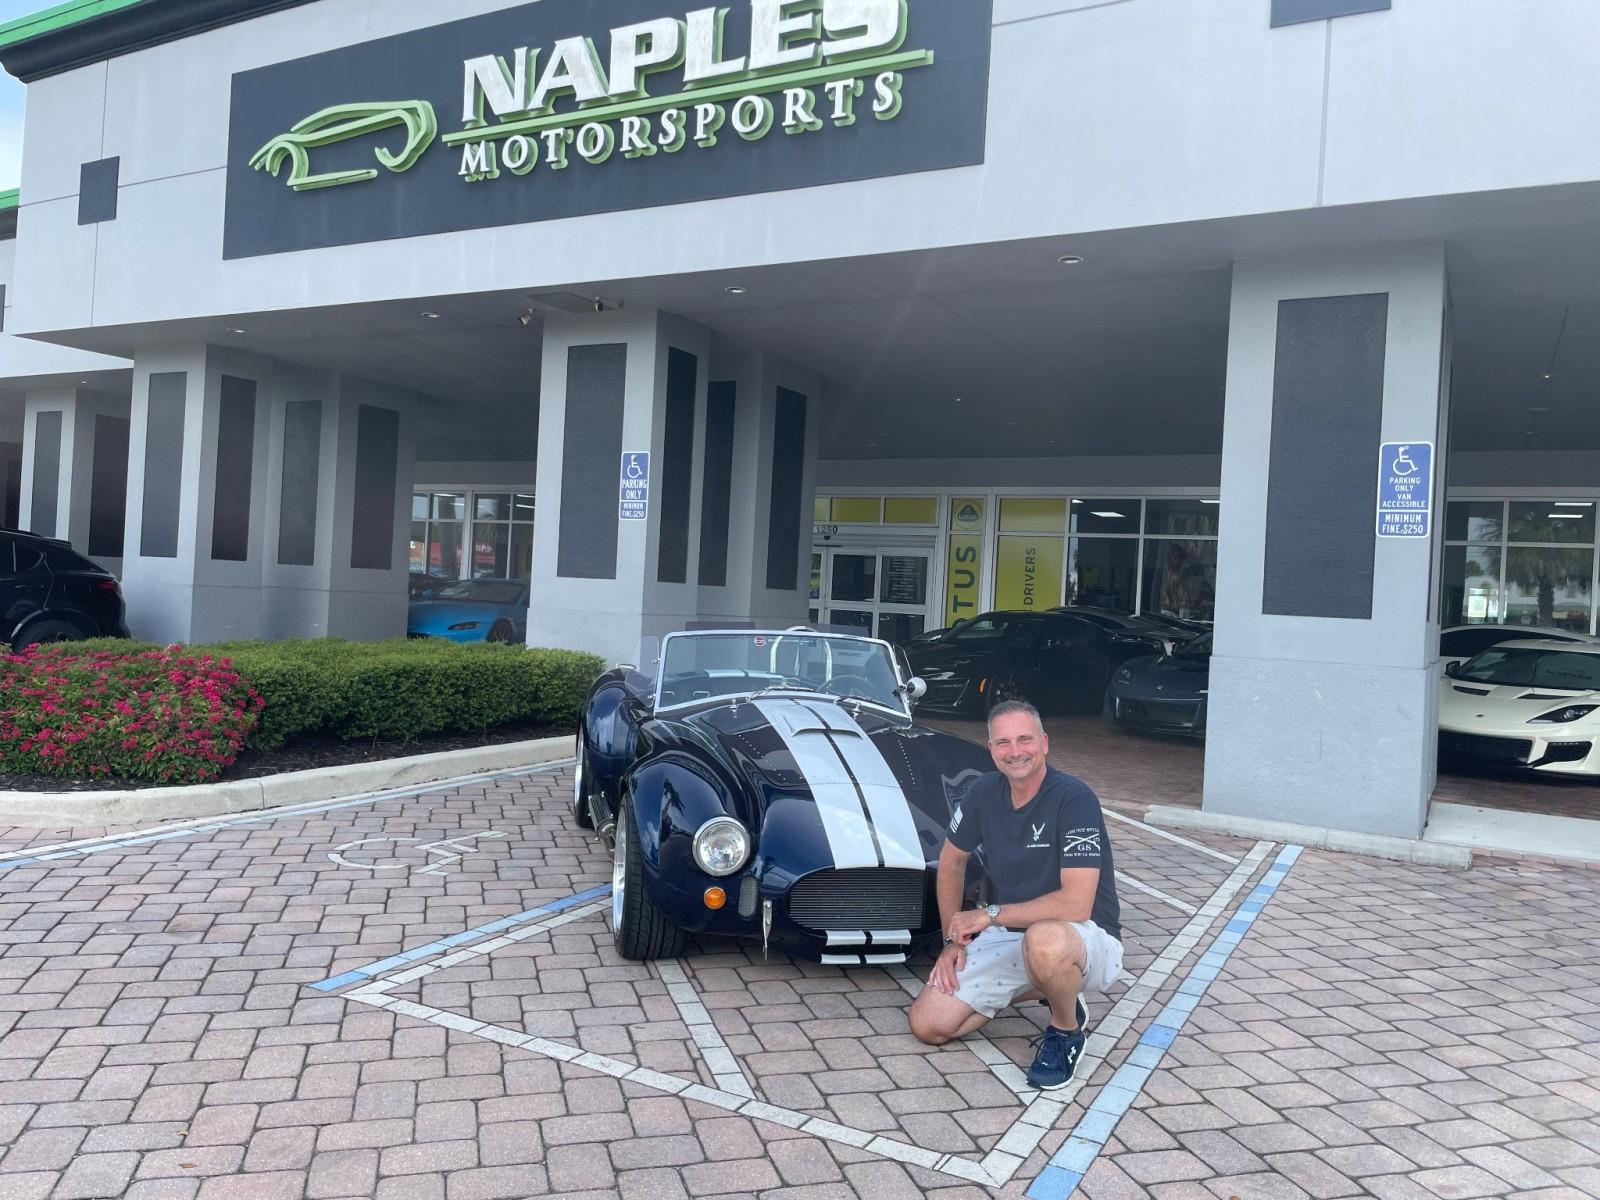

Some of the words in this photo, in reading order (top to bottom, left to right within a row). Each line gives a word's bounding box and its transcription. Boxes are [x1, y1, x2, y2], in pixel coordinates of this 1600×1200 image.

[461, 0, 908, 128] NAPLES
[458, 71, 903, 182] MOTORSPORTS
[621, 479, 647, 489] PARKING
[1389, 477, 1421, 485] PARKING
[625, 489, 642, 499] ONLY
[623, 502, 644, 510] MINIMUM
[1382, 500, 1426, 508] ACCESSIBLE
[1384, 513, 1422, 523] MINIMUM
[1382, 524, 1400, 533] FINE
[1402, 524, 1424, 534] $250
[1023, 546, 1036, 606] DRIVERS
[951, 545, 977, 628] TUS
